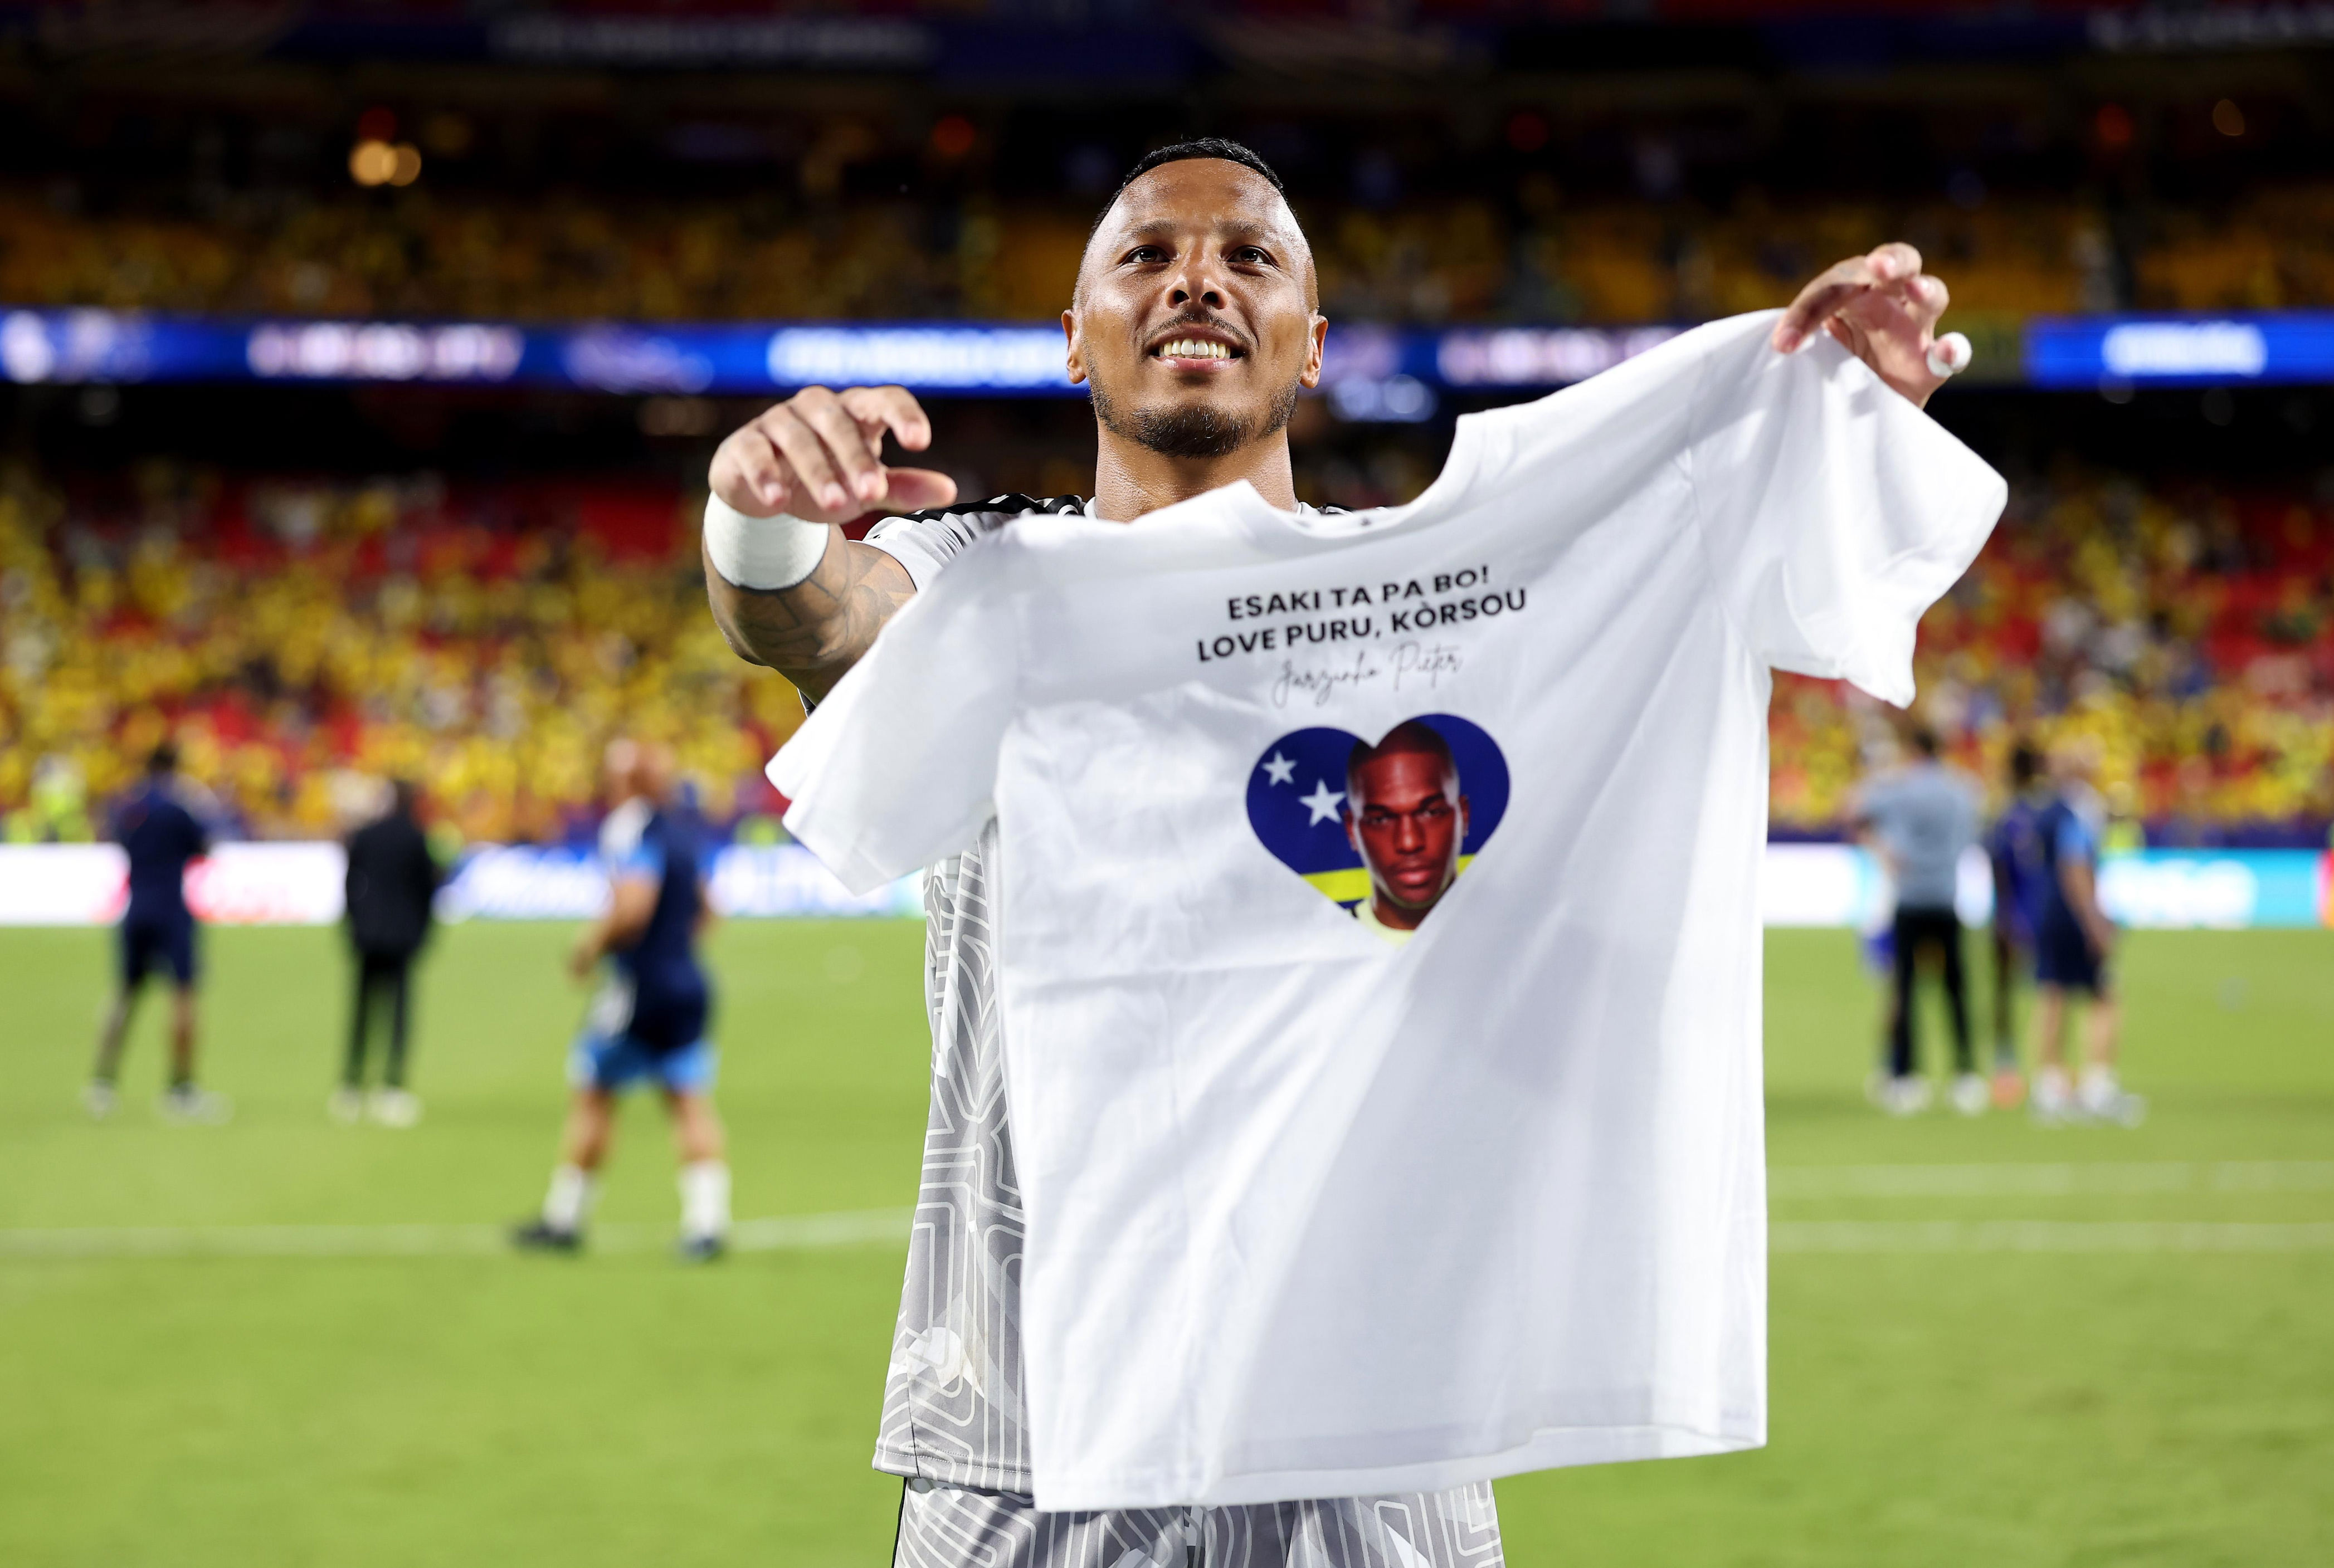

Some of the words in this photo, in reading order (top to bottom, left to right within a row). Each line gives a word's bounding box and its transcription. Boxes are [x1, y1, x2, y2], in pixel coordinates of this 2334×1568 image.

[1197, 628, 1276, 663] LOVE
[1285, 617, 1382, 647] PURU,
[1391, 588, 1526, 633] KÒRSOU
[1227, 590, 1321, 621] ESAKI
[1330, 587, 1372, 608] TA
[1382, 580, 1424, 603] PA
[1433, 565, 1488, 594] BO!
